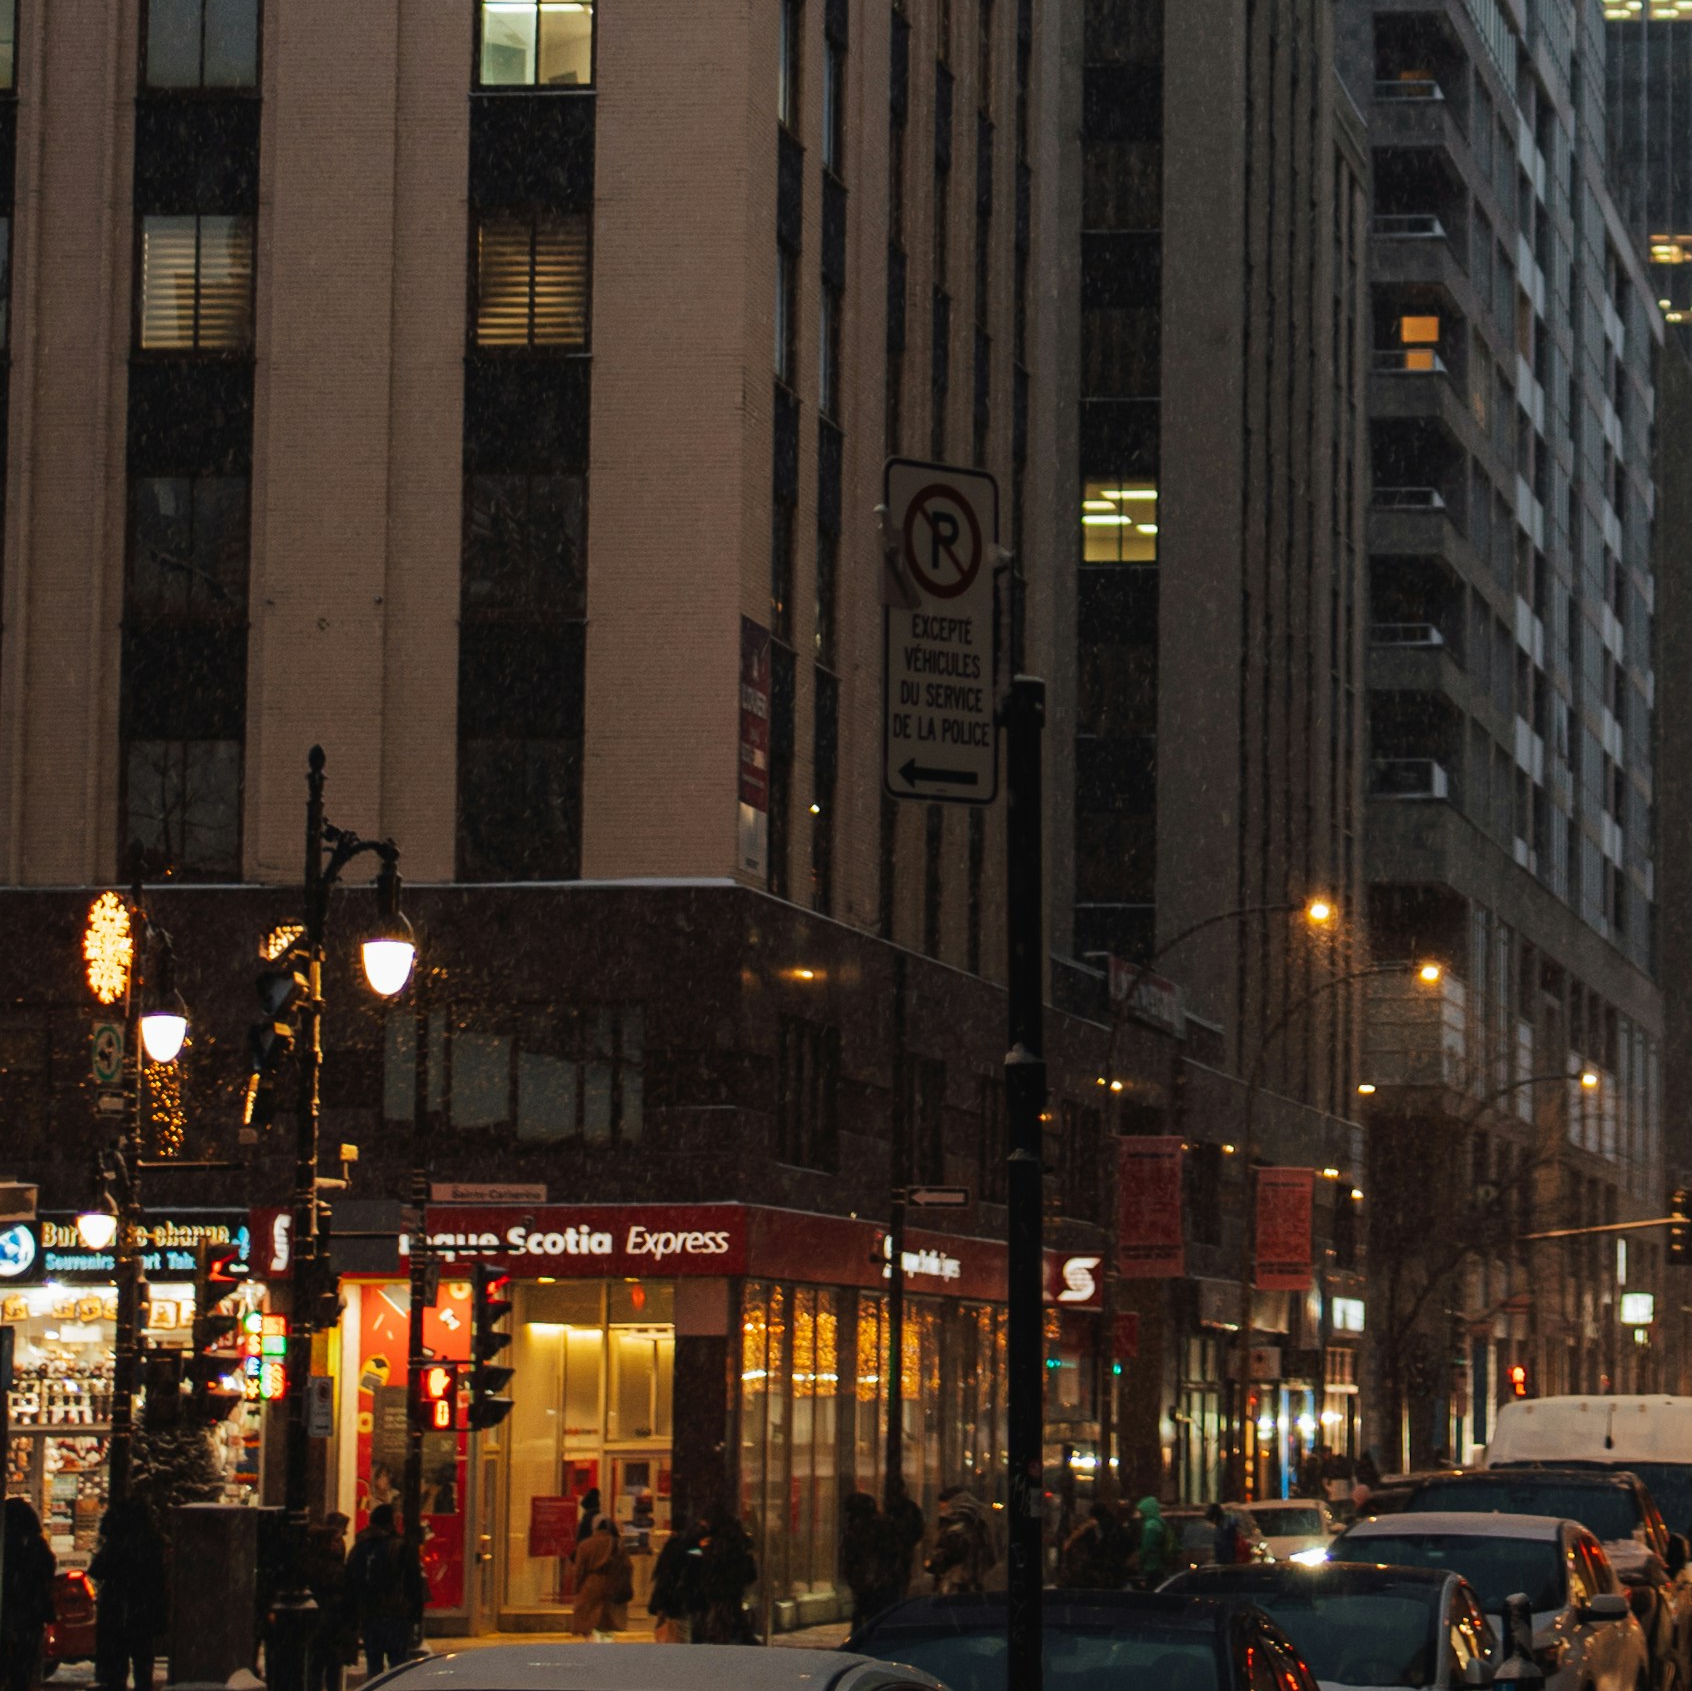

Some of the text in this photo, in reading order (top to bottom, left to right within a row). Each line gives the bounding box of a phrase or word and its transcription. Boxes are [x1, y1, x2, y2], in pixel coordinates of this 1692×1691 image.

[912, 614, 973, 645] EXCEPTÉ
[905, 644, 981, 679] VÉHICULES
[901, 680, 983, 713] DU SERVICE
[893, 713, 990, 747] DE LA POLICE
[507, 1225, 613, 1255] Scotia
[626, 1226, 730, 1262] Express
